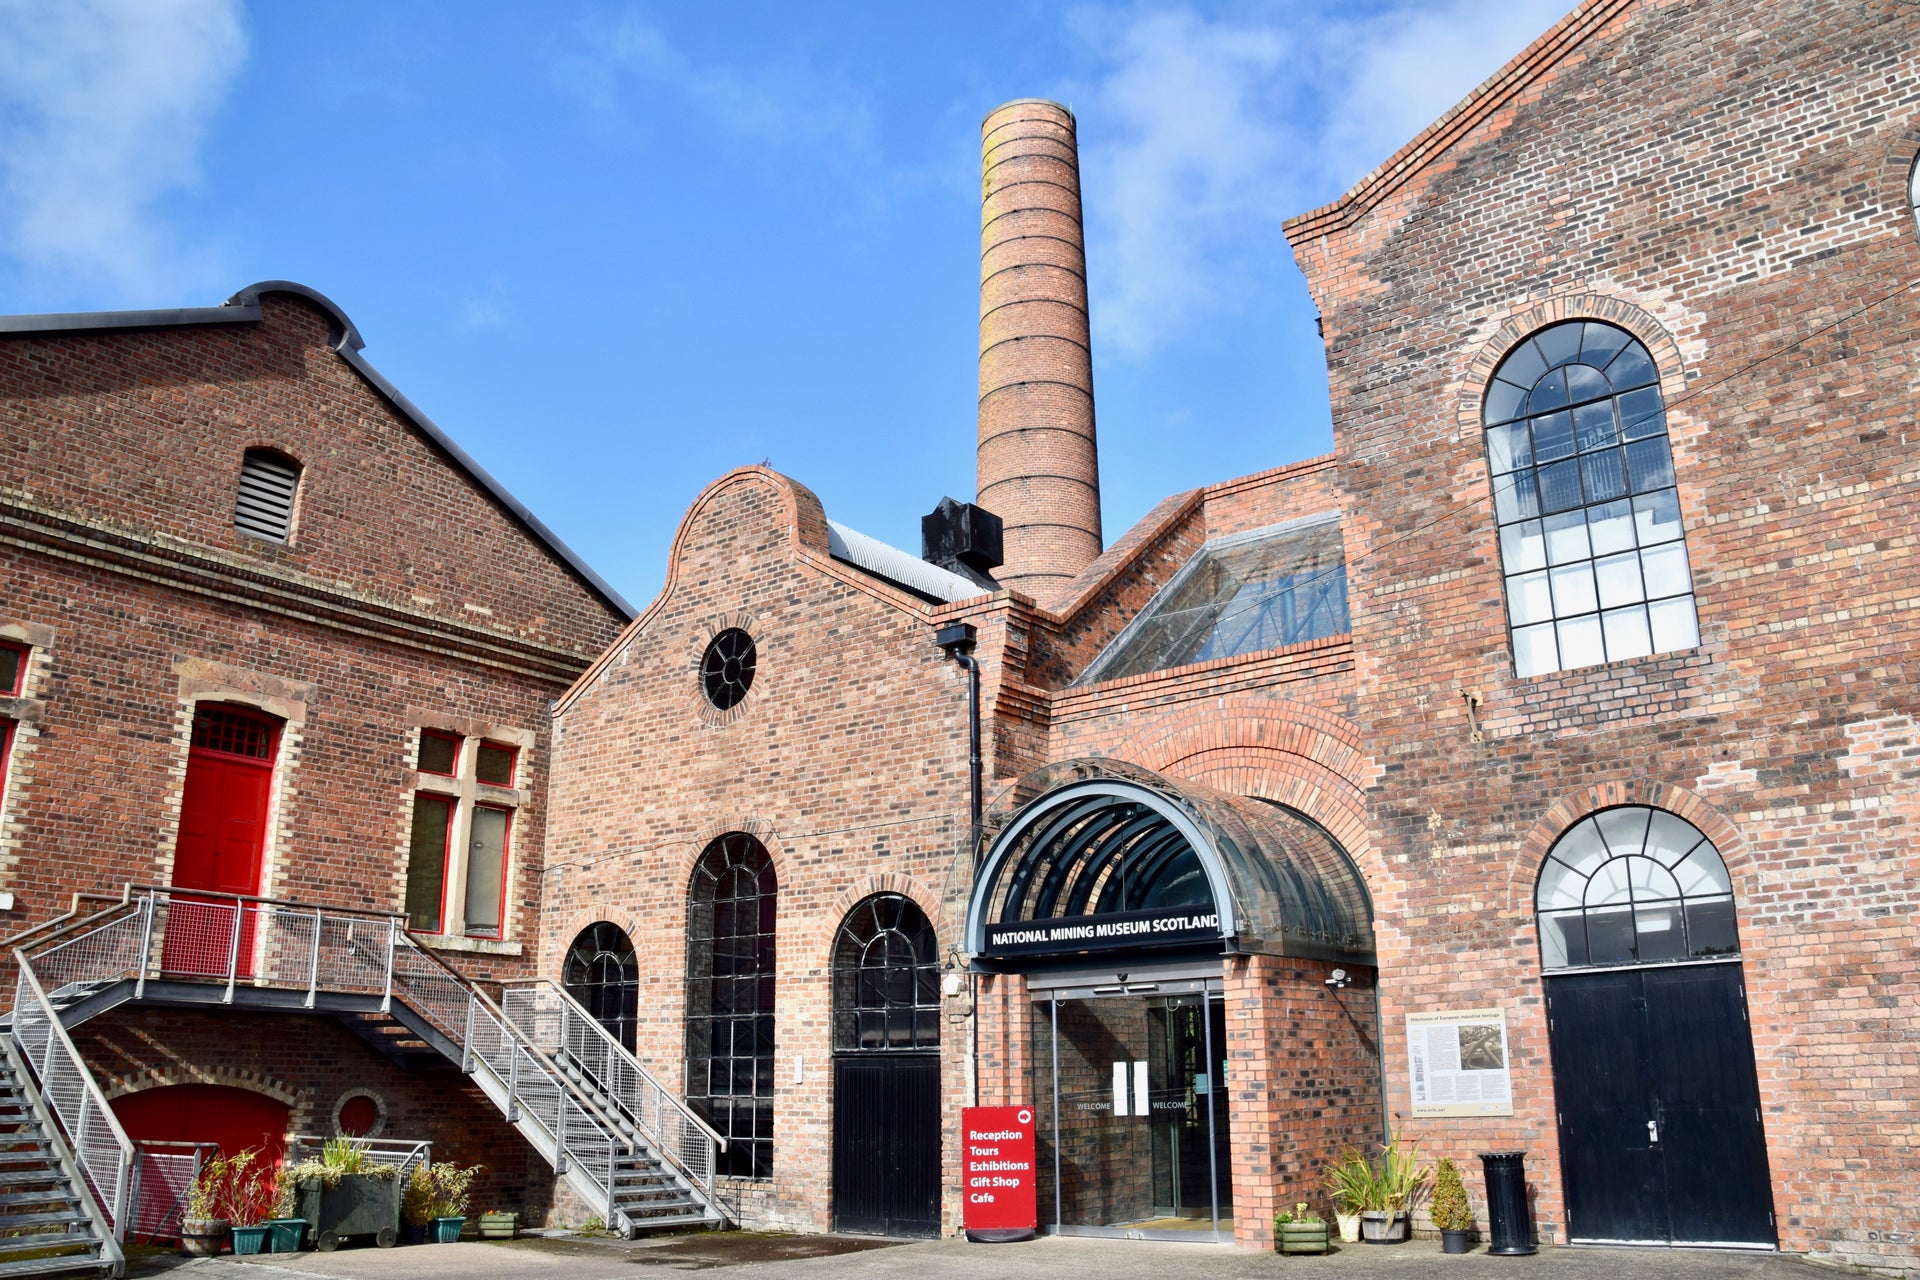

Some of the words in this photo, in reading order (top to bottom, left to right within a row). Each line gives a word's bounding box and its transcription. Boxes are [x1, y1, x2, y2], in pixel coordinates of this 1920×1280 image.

[992, 930, 1048, 945] NATIONAL
[1050, 925, 1094, 942] MINING
[1096, 920, 1150, 937] MUSEUM
[1152, 914, 1219, 932] SCOTLAND
[1077, 1102, 1111, 1110] WELCOME
[1152, 1101, 1188, 1109] WELCOME
[969, 1130, 1022, 1142] Reception
[969, 1146, 999, 1156] Tours
[970, 1161, 1029, 1172] Exhibitions
[970, 1177, 991, 1187] Gift
[992, 1176, 1020, 1188] Shop
[970, 1192, 995, 1203] Cafe
